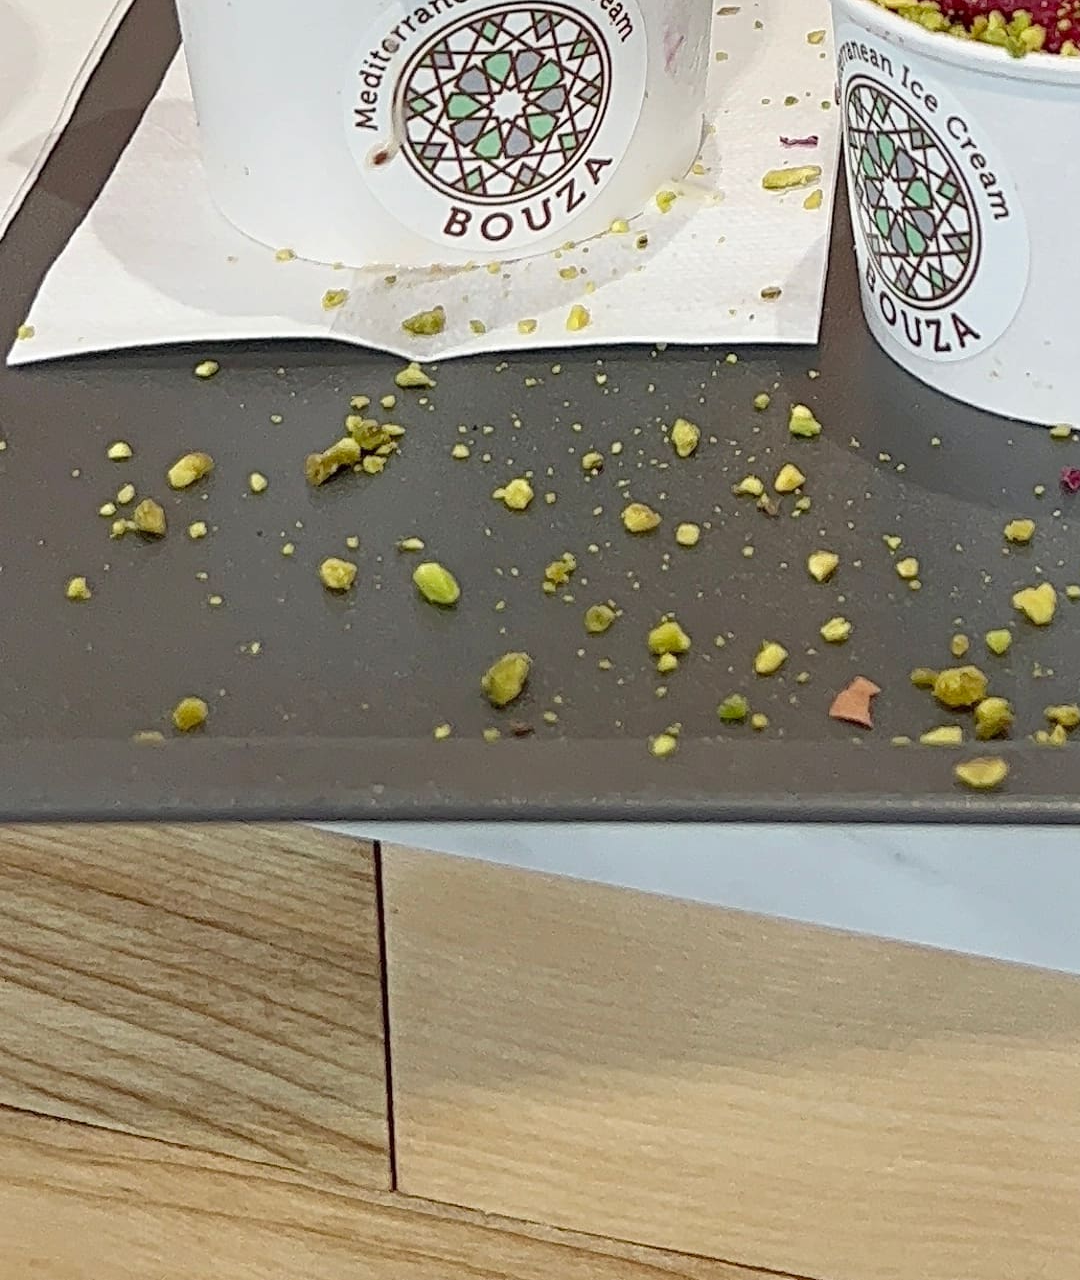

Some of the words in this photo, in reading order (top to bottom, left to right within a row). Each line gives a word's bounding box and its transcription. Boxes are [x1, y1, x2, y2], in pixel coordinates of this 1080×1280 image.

[900, 64, 938, 113] Ice
[946, 115, 1010, 221] Cream
[443, 156, 613, 241] BOUZA
[866, 258, 981, 353] BOUZA
